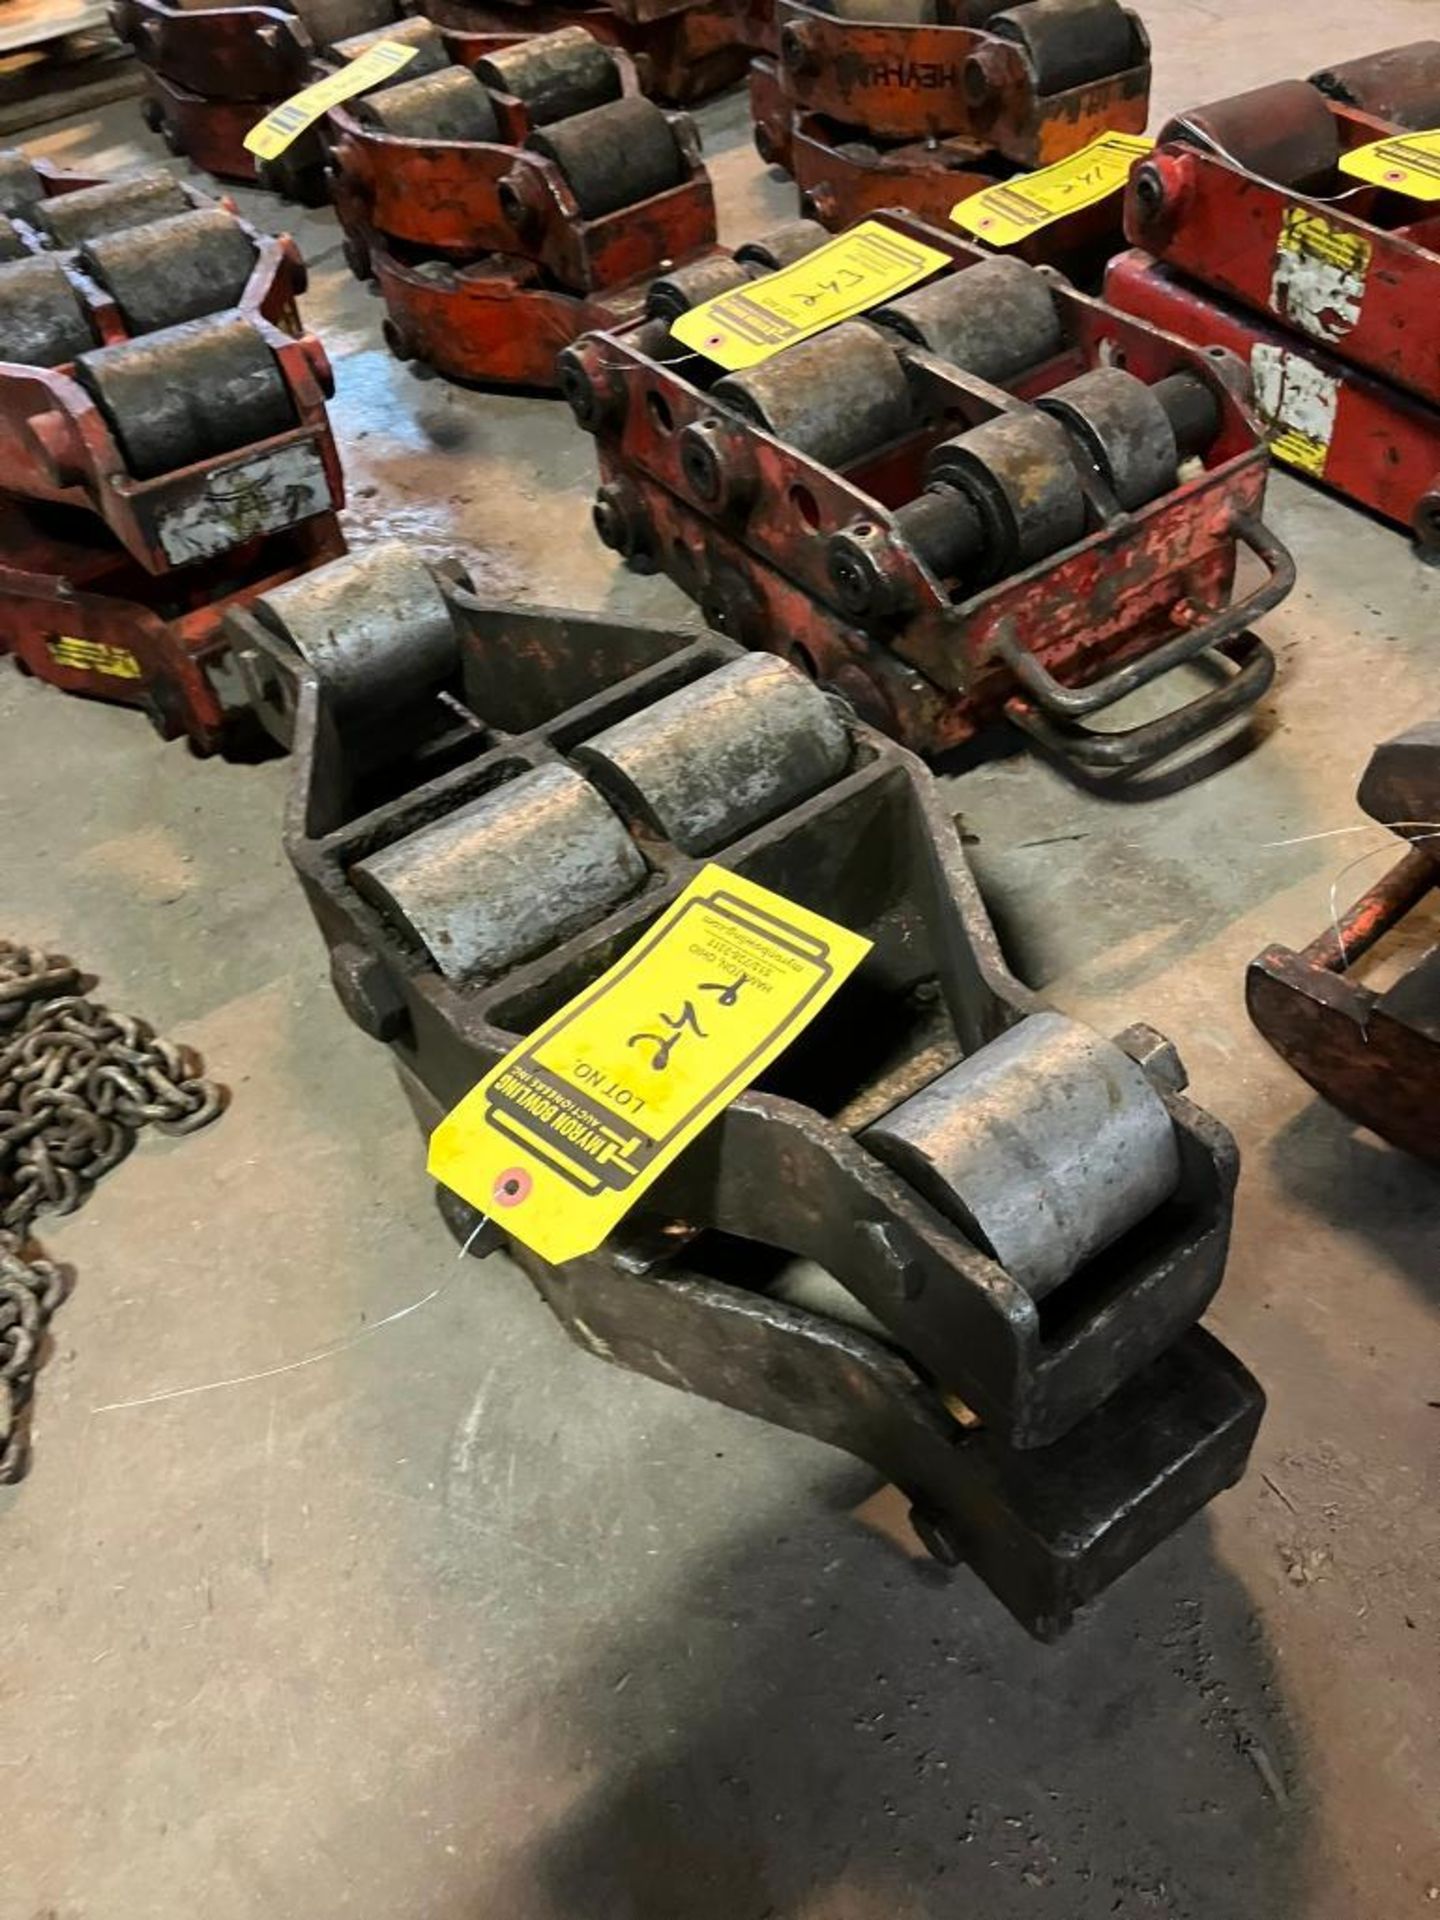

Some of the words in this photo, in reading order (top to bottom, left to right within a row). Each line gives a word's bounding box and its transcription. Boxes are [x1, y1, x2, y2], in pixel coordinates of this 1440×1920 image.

[572, 1058, 606, 1089] NO.
[493, 1073, 560, 1124] BOWLING
[530, 1075, 603, 1128] AUCTIONEERS
[602, 1082, 647, 1115] LOT
[550, 1112, 608, 1157] MYRON
